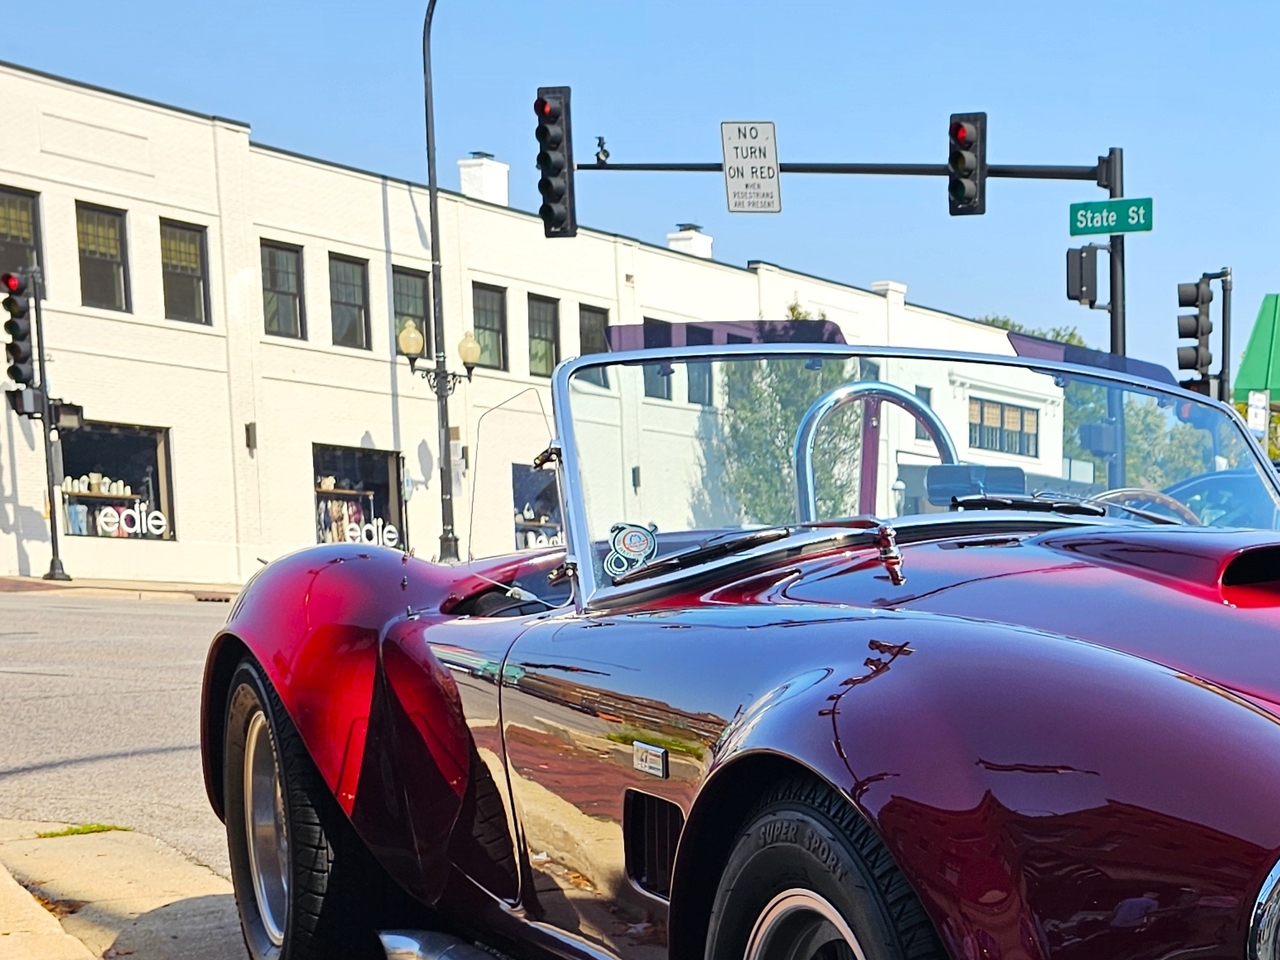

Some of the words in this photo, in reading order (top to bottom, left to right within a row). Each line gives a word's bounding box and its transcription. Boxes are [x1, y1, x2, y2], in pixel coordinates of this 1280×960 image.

[738, 126, 758, 140] NO
[733, 146, 767, 160] TURN
[728, 166, 745, 179] ON
[751, 166, 775, 179] RED
[748, 200, 774, 209] PRESENT
[1076, 208, 1117, 228] State
[1128, 205, 1145, 225] St
[99, 498, 167, 535] edie
[345, 517, 399, 547] edie
[759, 820, 800, 846] SUPER
[804, 828, 849, 882] SPORT
